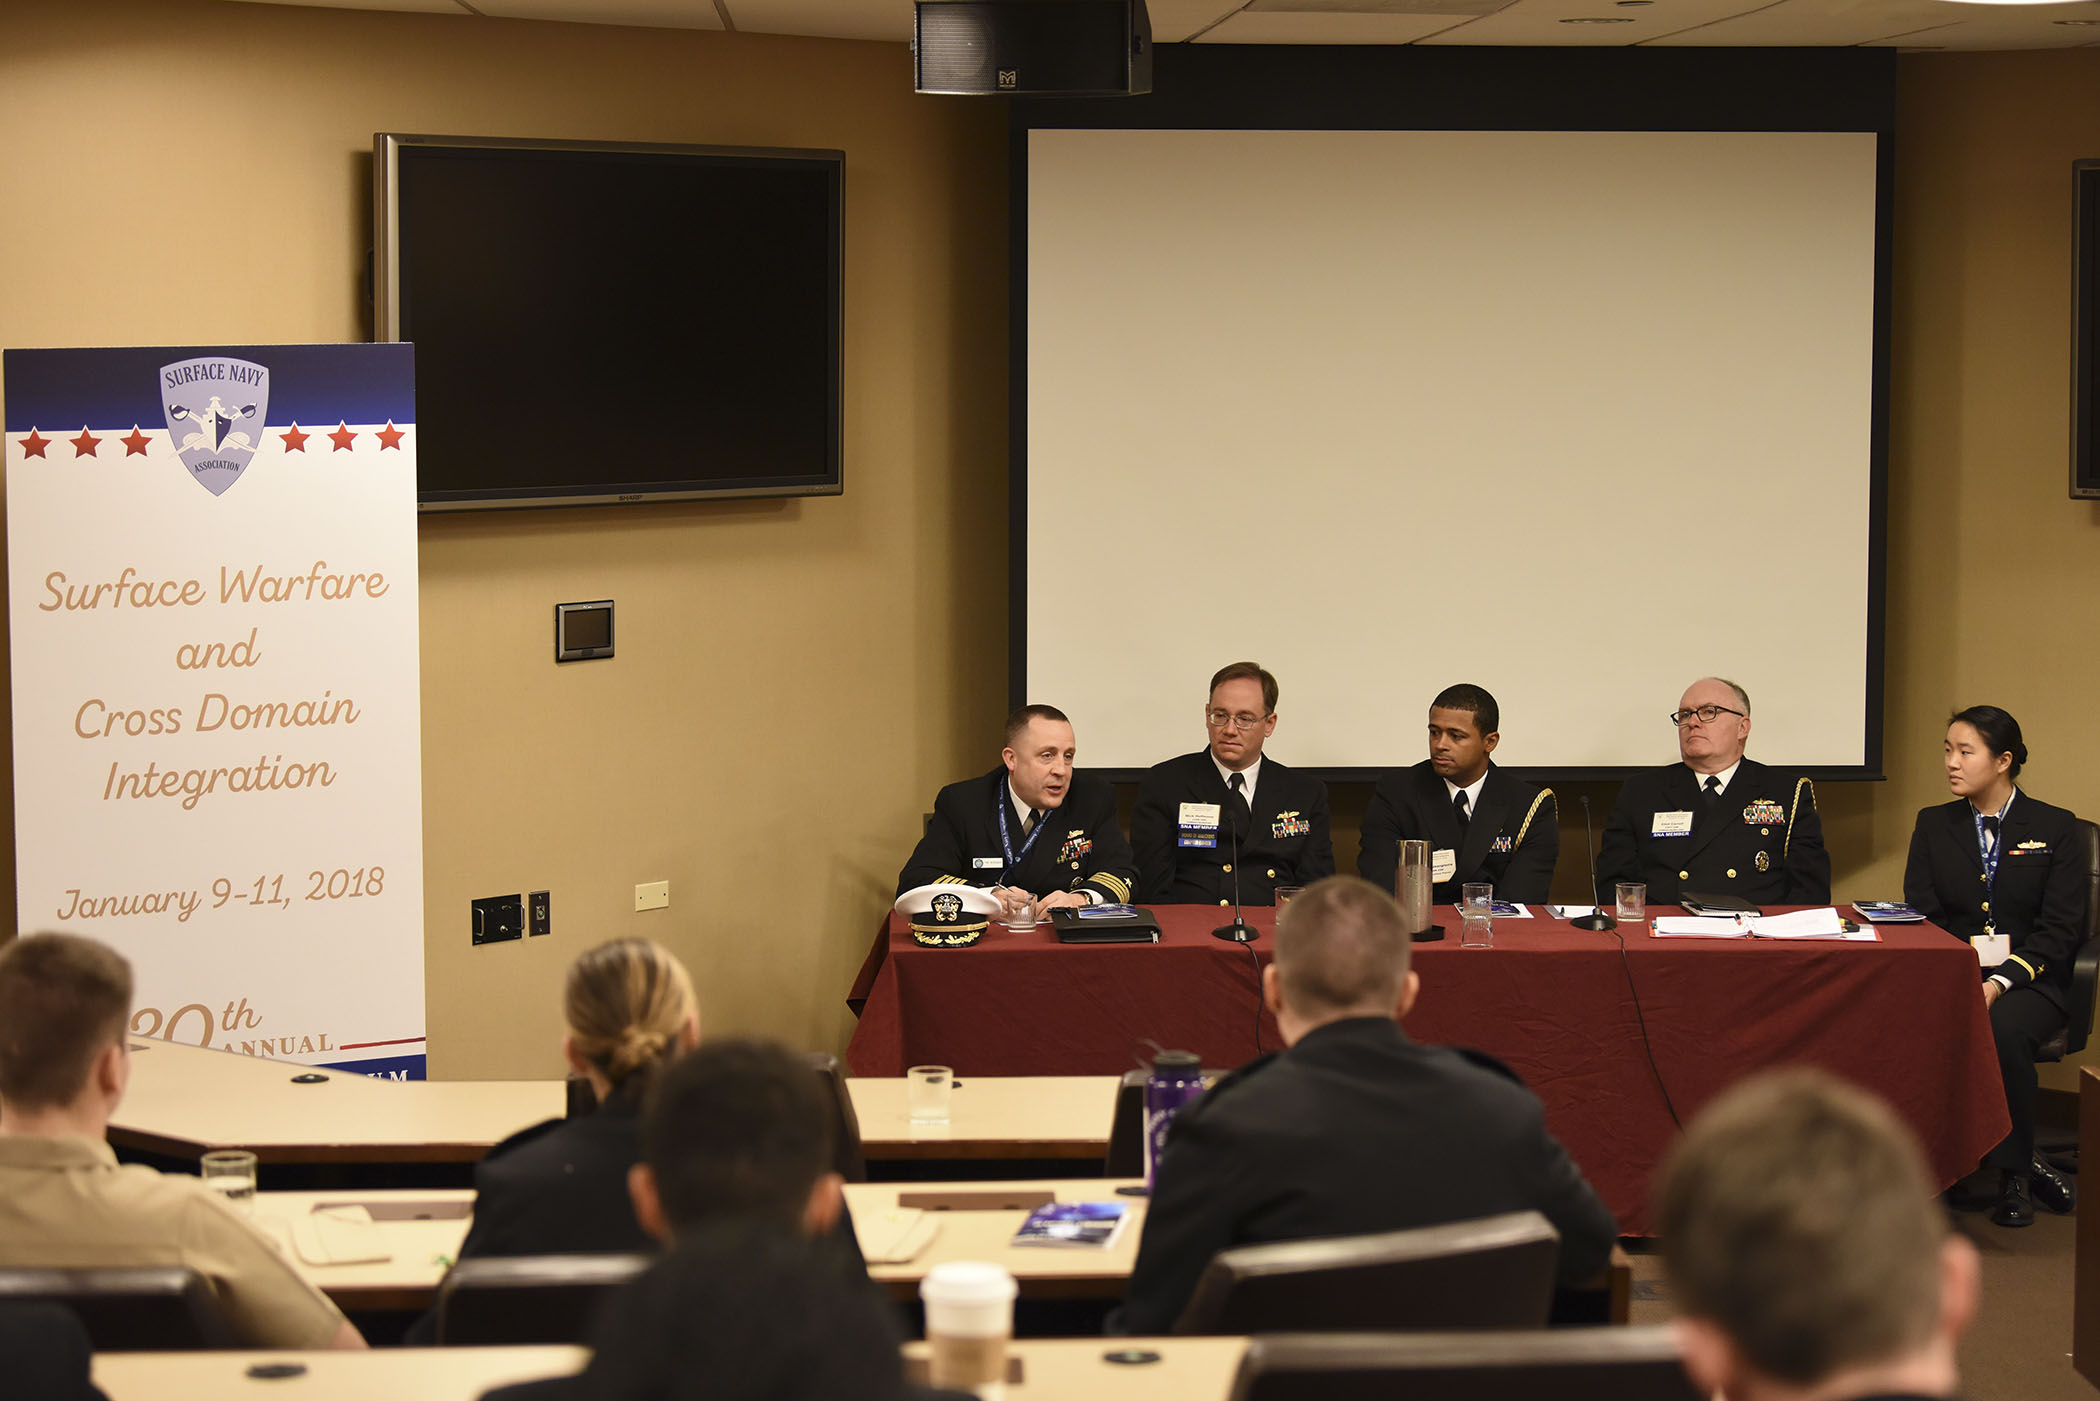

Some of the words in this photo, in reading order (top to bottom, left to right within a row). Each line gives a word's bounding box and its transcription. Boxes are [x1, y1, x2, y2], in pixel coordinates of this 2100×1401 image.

[165, 363, 225, 389] SURFACE
[229, 364, 264, 387] NAVY
[194, 460, 240, 473] ASSOCIATION
[39, 567, 206, 612] Surface
[219, 561, 390, 604] Warfare
[176, 628, 262, 670] and
[75, 699, 182, 740] Cross
[196, 690, 361, 732] Domain
[103, 755, 337, 811] Integration
[57, 887, 202, 923] January
[212, 874, 291, 910] 9-11,
[305, 866, 385, 902] 2018
[223, 1034, 334, 1058] ANNUAL
